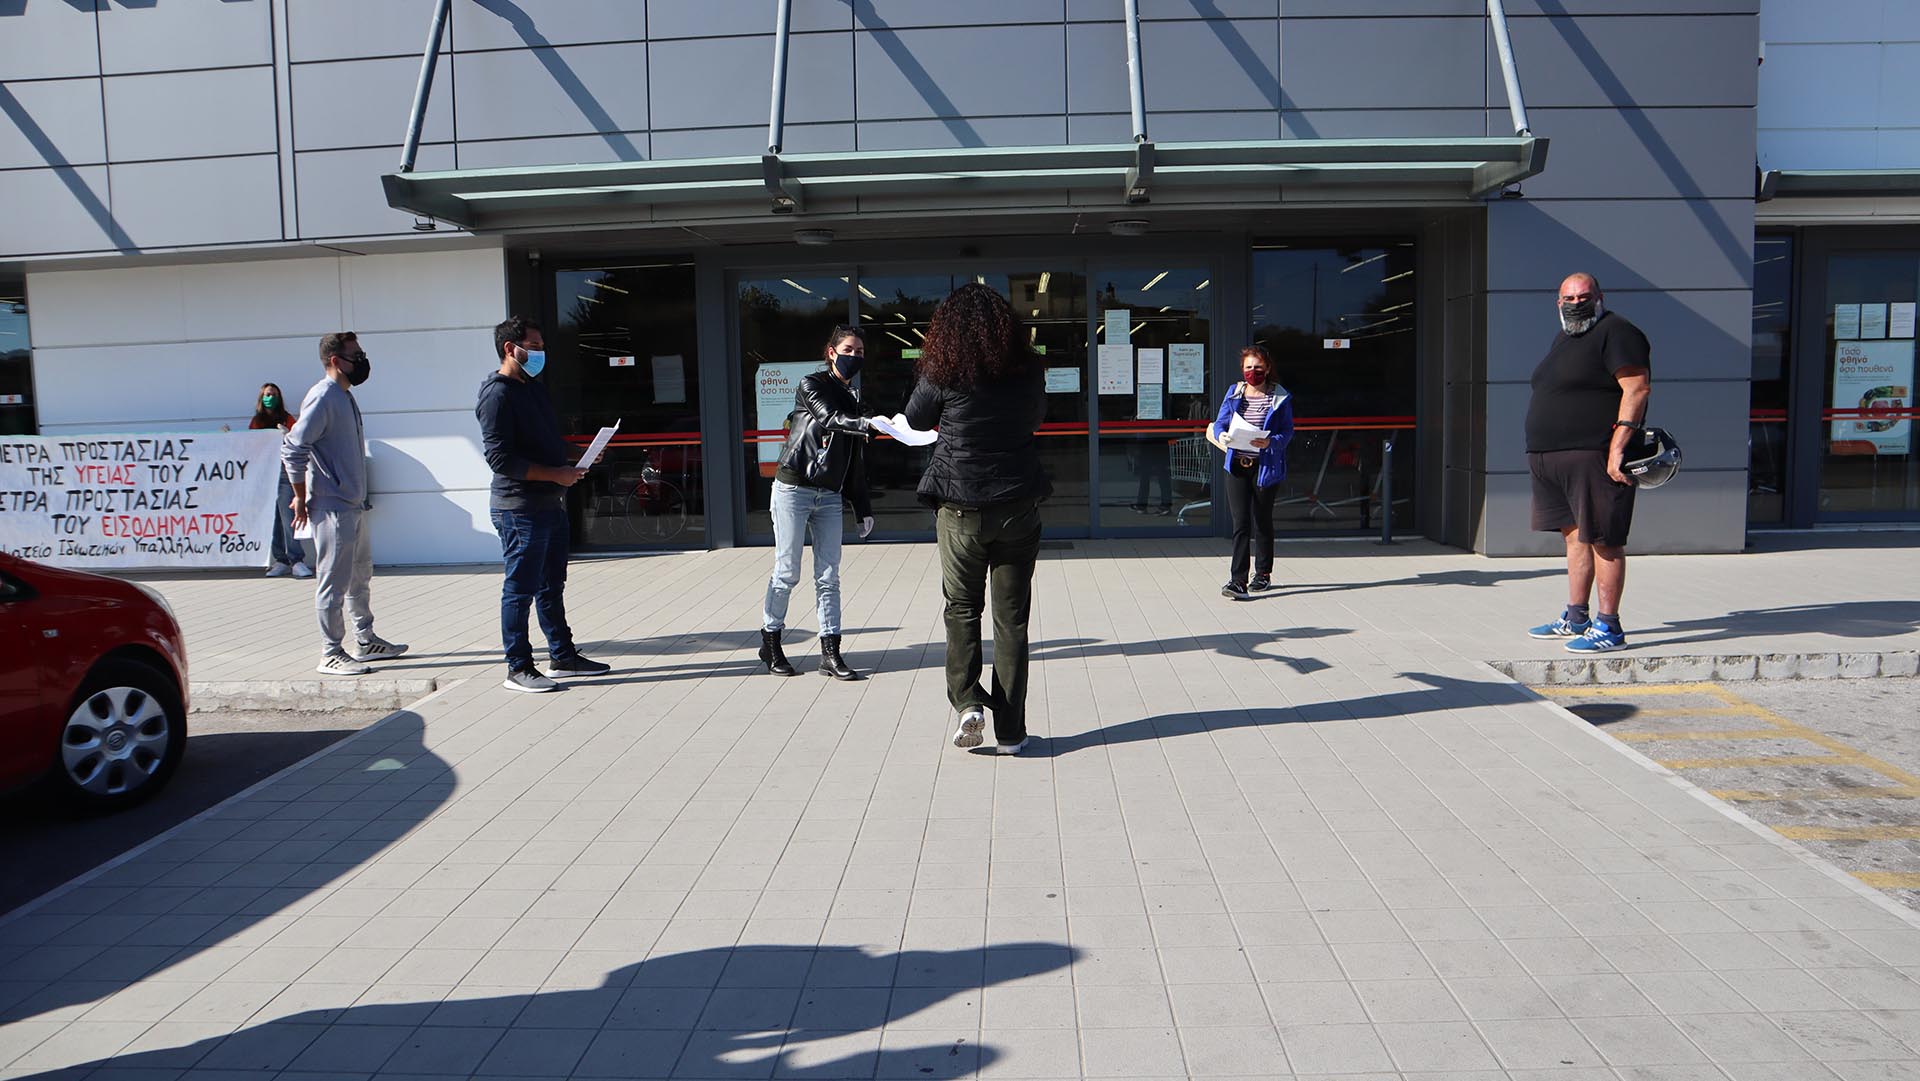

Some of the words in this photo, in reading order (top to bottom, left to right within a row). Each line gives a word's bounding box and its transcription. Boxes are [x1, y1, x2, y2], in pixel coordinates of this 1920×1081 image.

[1840, 355, 1868, 365] φθηνά
[761, 368, 781, 376] Τόσο
[761, 376, 788, 387] φθηνά
[761, 386, 777, 395] όσο
[59, 439, 194, 462] ΠΡΟΣΤΑΣΙΑΣ
[27, 466, 65, 486] ΤΗΣ
[74, 464, 136, 485] ΥΓΕΙΑΣ
[148, 464, 184, 483] ΤΟΥ
[195, 460, 249, 481] ΛΑΟΥ
[66, 486, 199, 512] ΠΡΟΣΤΑΣΙΑΣ
[51, 513, 91, 535] ΤΟΥ
[101, 512, 239, 538] ΕΙΣΟΔΗΜΑΤΟΣ
[58, 539, 125, 556] Ιδιωτικών
[133, 536, 214, 559] Υπαλλήλων
[219, 533, 261, 553] Ρόδου
